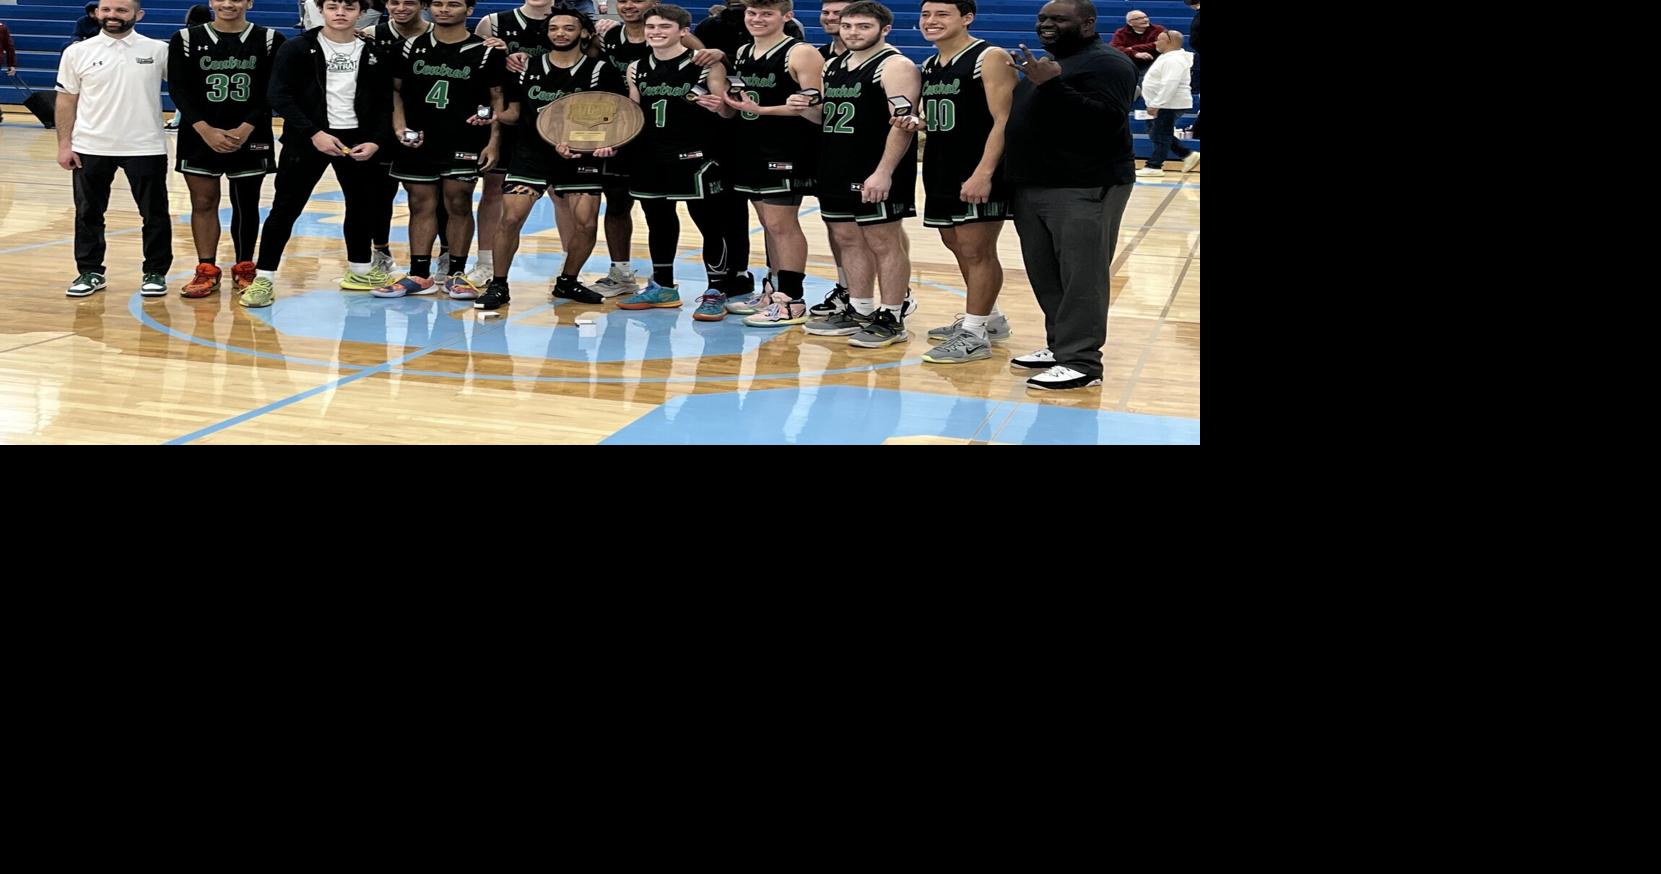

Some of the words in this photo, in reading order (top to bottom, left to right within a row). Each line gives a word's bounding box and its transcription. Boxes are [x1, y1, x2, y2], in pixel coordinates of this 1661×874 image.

[199, 55, 258, 71] Central
[412, 59, 472, 80] Central
[205, 73, 251, 103] 33
[425, 79, 449, 109] 4
[639, 81, 691, 97] Central
[651, 98, 668, 128] 1
[823, 101, 856, 134] 22
[926, 98, 956, 132] 40
